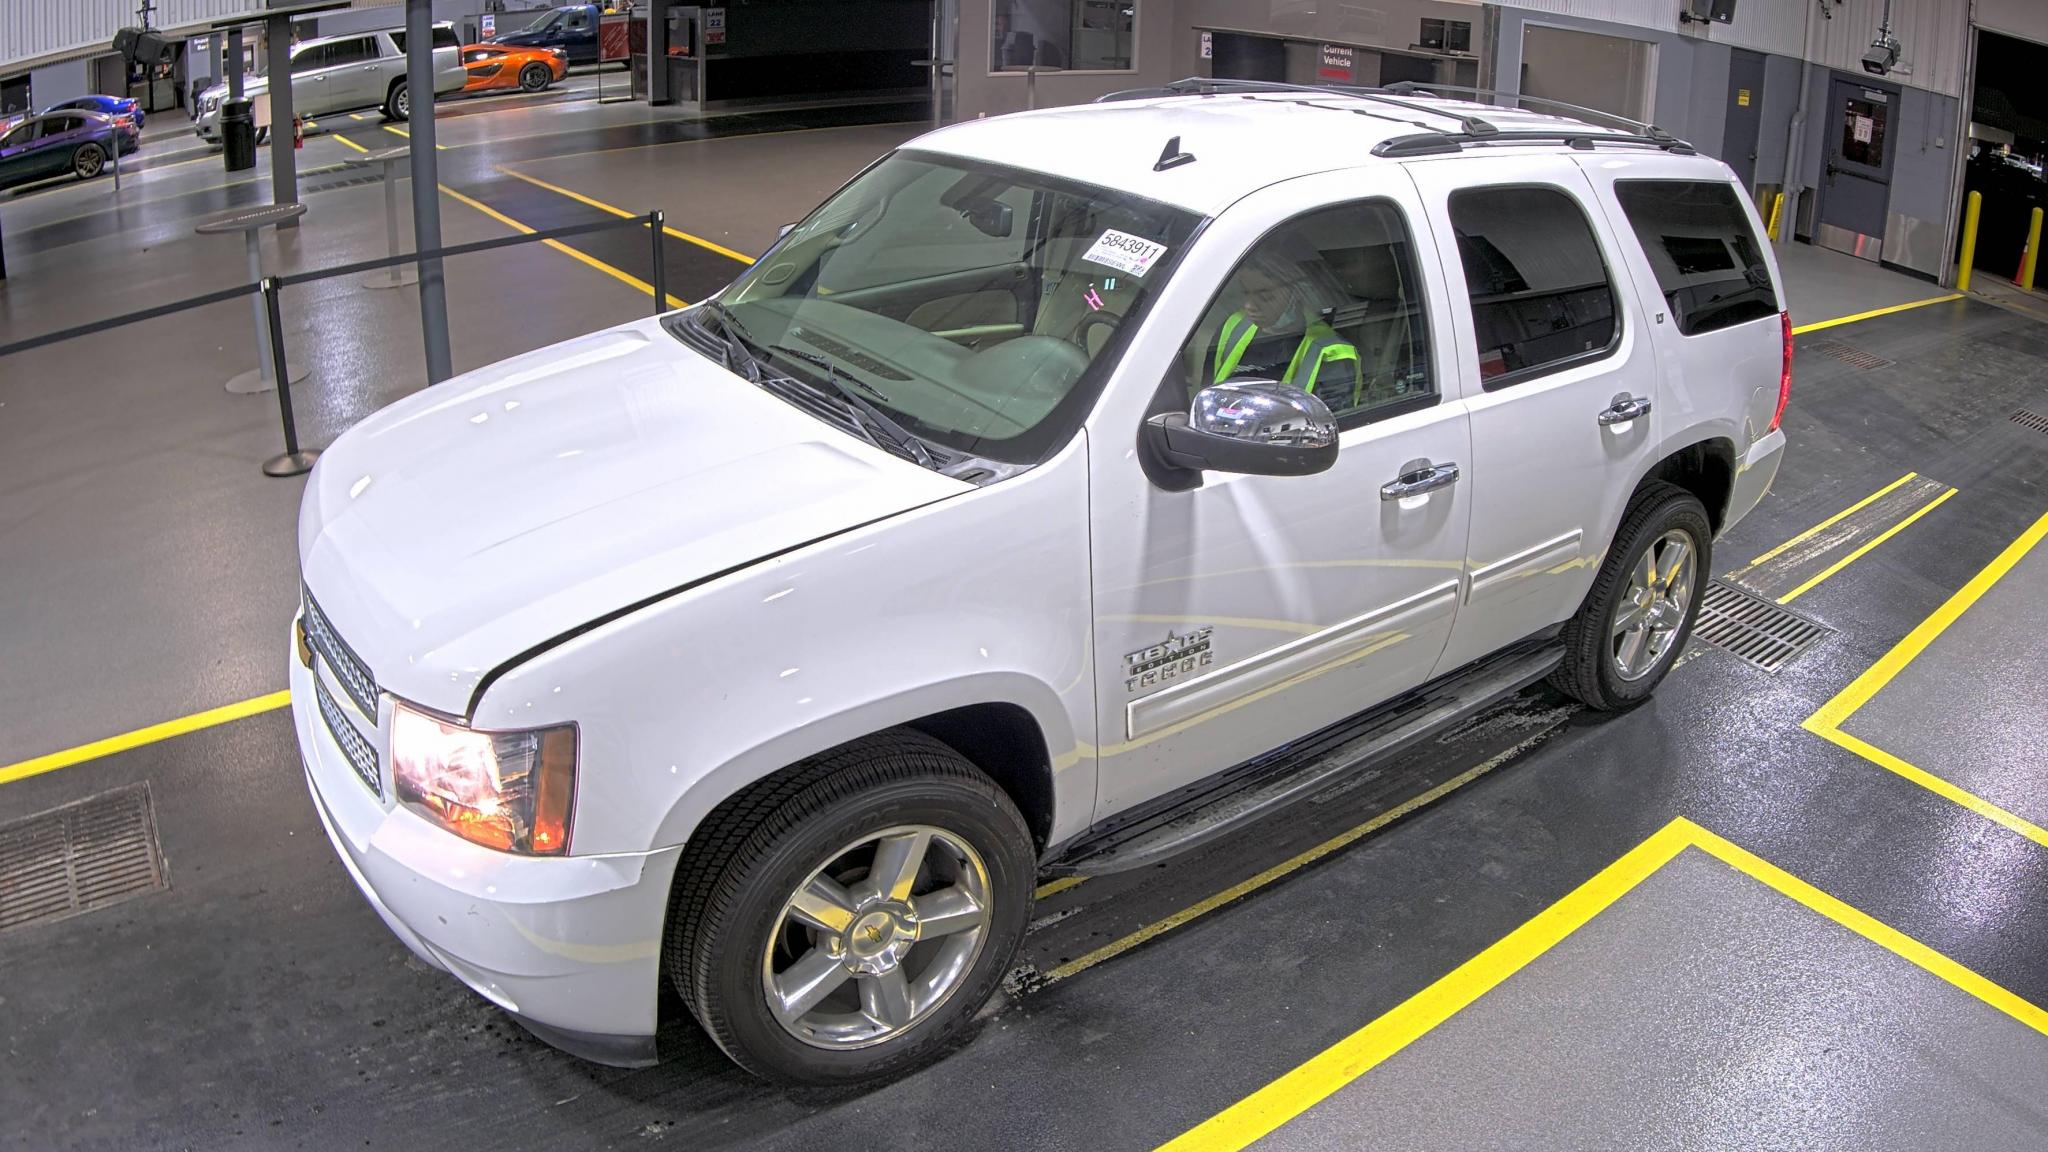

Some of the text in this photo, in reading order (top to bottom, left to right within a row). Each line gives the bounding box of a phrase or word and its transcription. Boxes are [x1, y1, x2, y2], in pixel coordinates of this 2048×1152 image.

[1323, 44, 1353, 56] Current
[1323, 55, 1352, 67] Vehicle
[1101, 233, 1160, 259] 5843911
[1125, 650, 1213, 692] TAHOE
